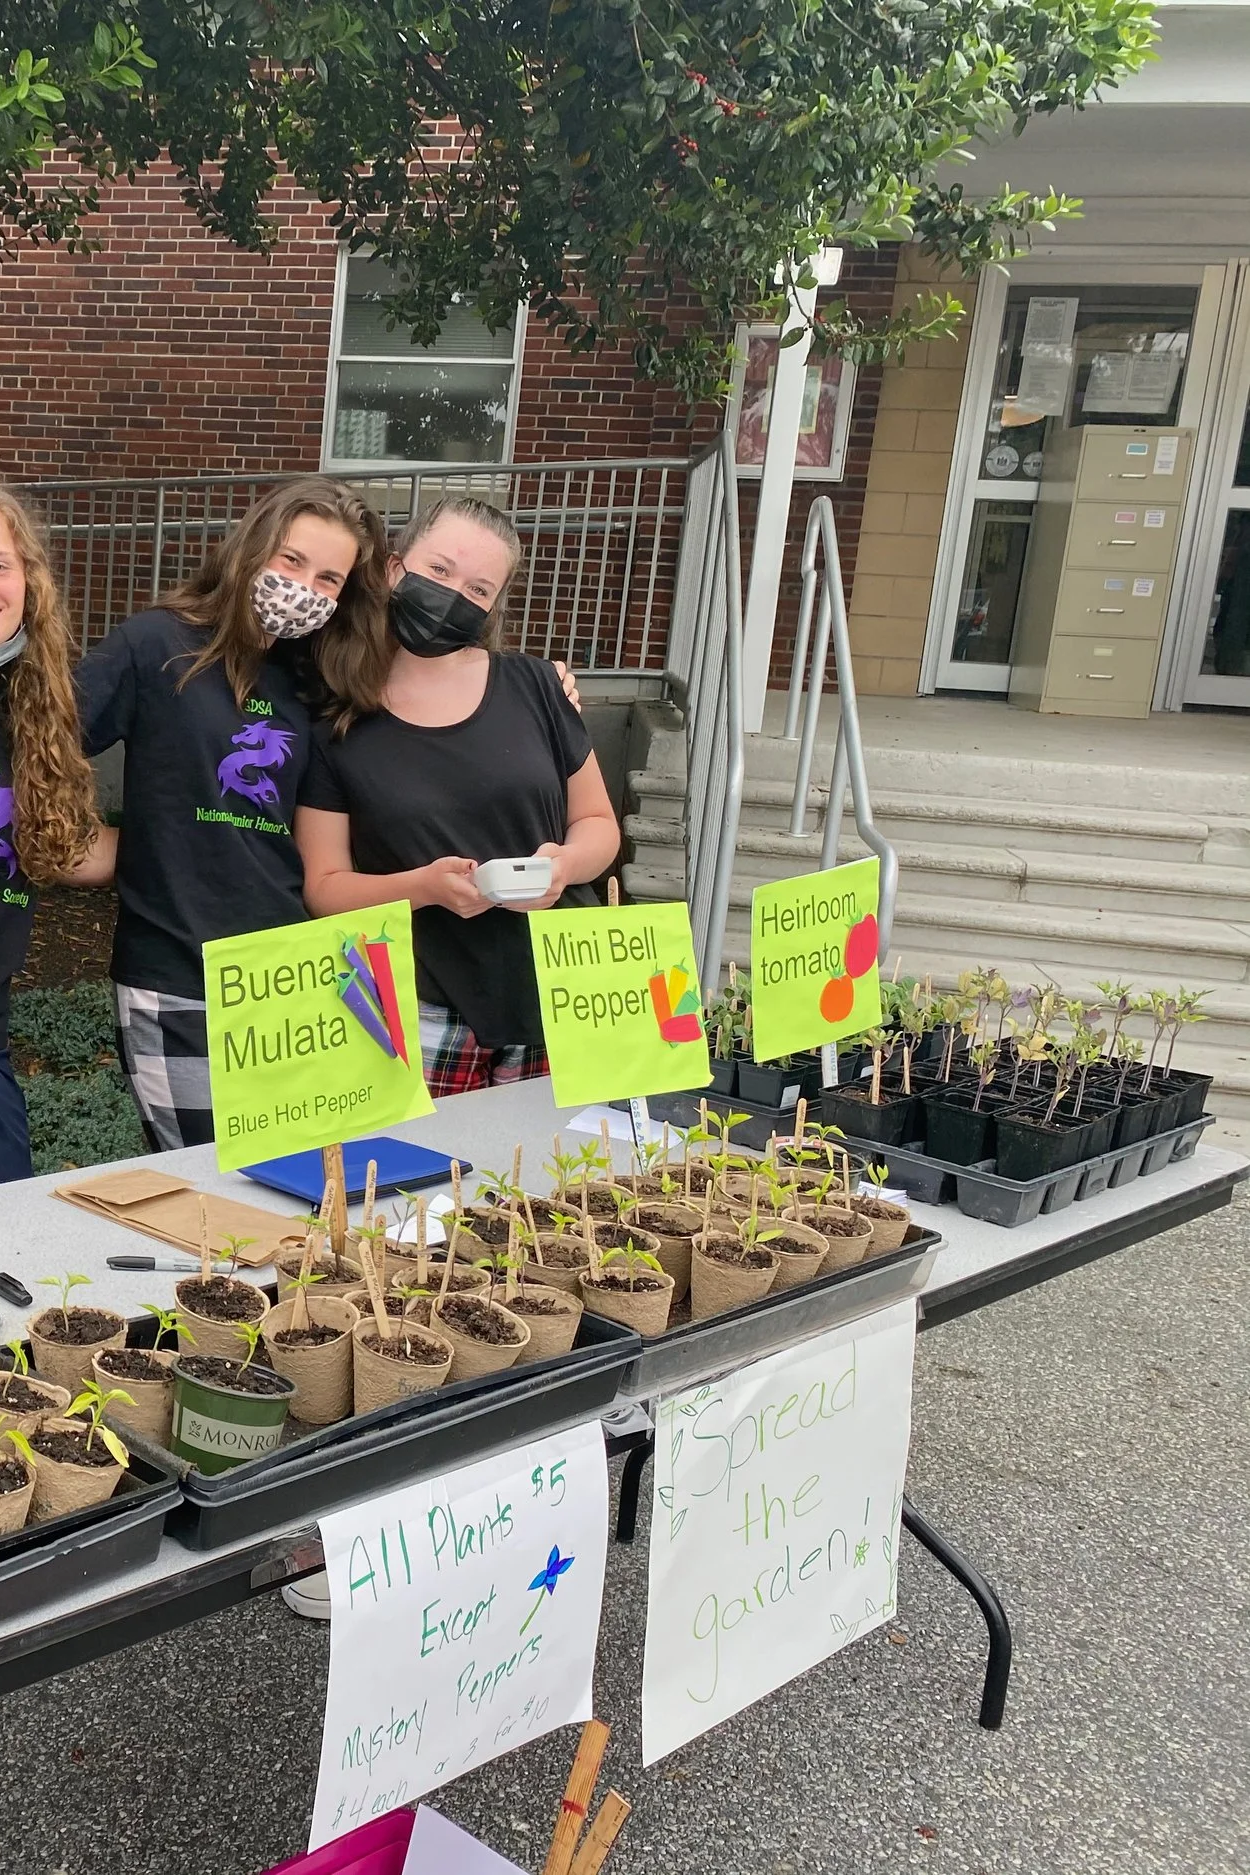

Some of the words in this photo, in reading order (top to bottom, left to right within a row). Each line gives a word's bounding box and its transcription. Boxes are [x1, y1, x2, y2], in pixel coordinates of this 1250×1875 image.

[255, 816, 283, 834] Honor
[760, 891, 858, 938] Heirloom
[542, 931, 601, 969] Mini
[607, 925, 658, 963] Bell
[760, 942, 842, 987] tomato
[219, 954, 338, 1009] Buena
[550, 986, 649, 1029] Pepper
[223, 1012, 349, 1073] Mulata
[227, 1113, 269, 1138] Blue
[275, 1101, 309, 1126] Hot
[314, 1084, 374, 1113] Pepper
[691, 1340, 856, 1502] Spread
[348, 1519, 413, 1610] All
[428, 1493, 514, 1571] Plants
[530, 1458, 568, 1508] $5
[732, 1474, 821, 1546] the
[419, 1583, 498, 1660] Except
[455, 1633, 543, 1717] Peppers
[371, 1779, 409, 1816] each
[463, 1737, 479, 1764] 3
